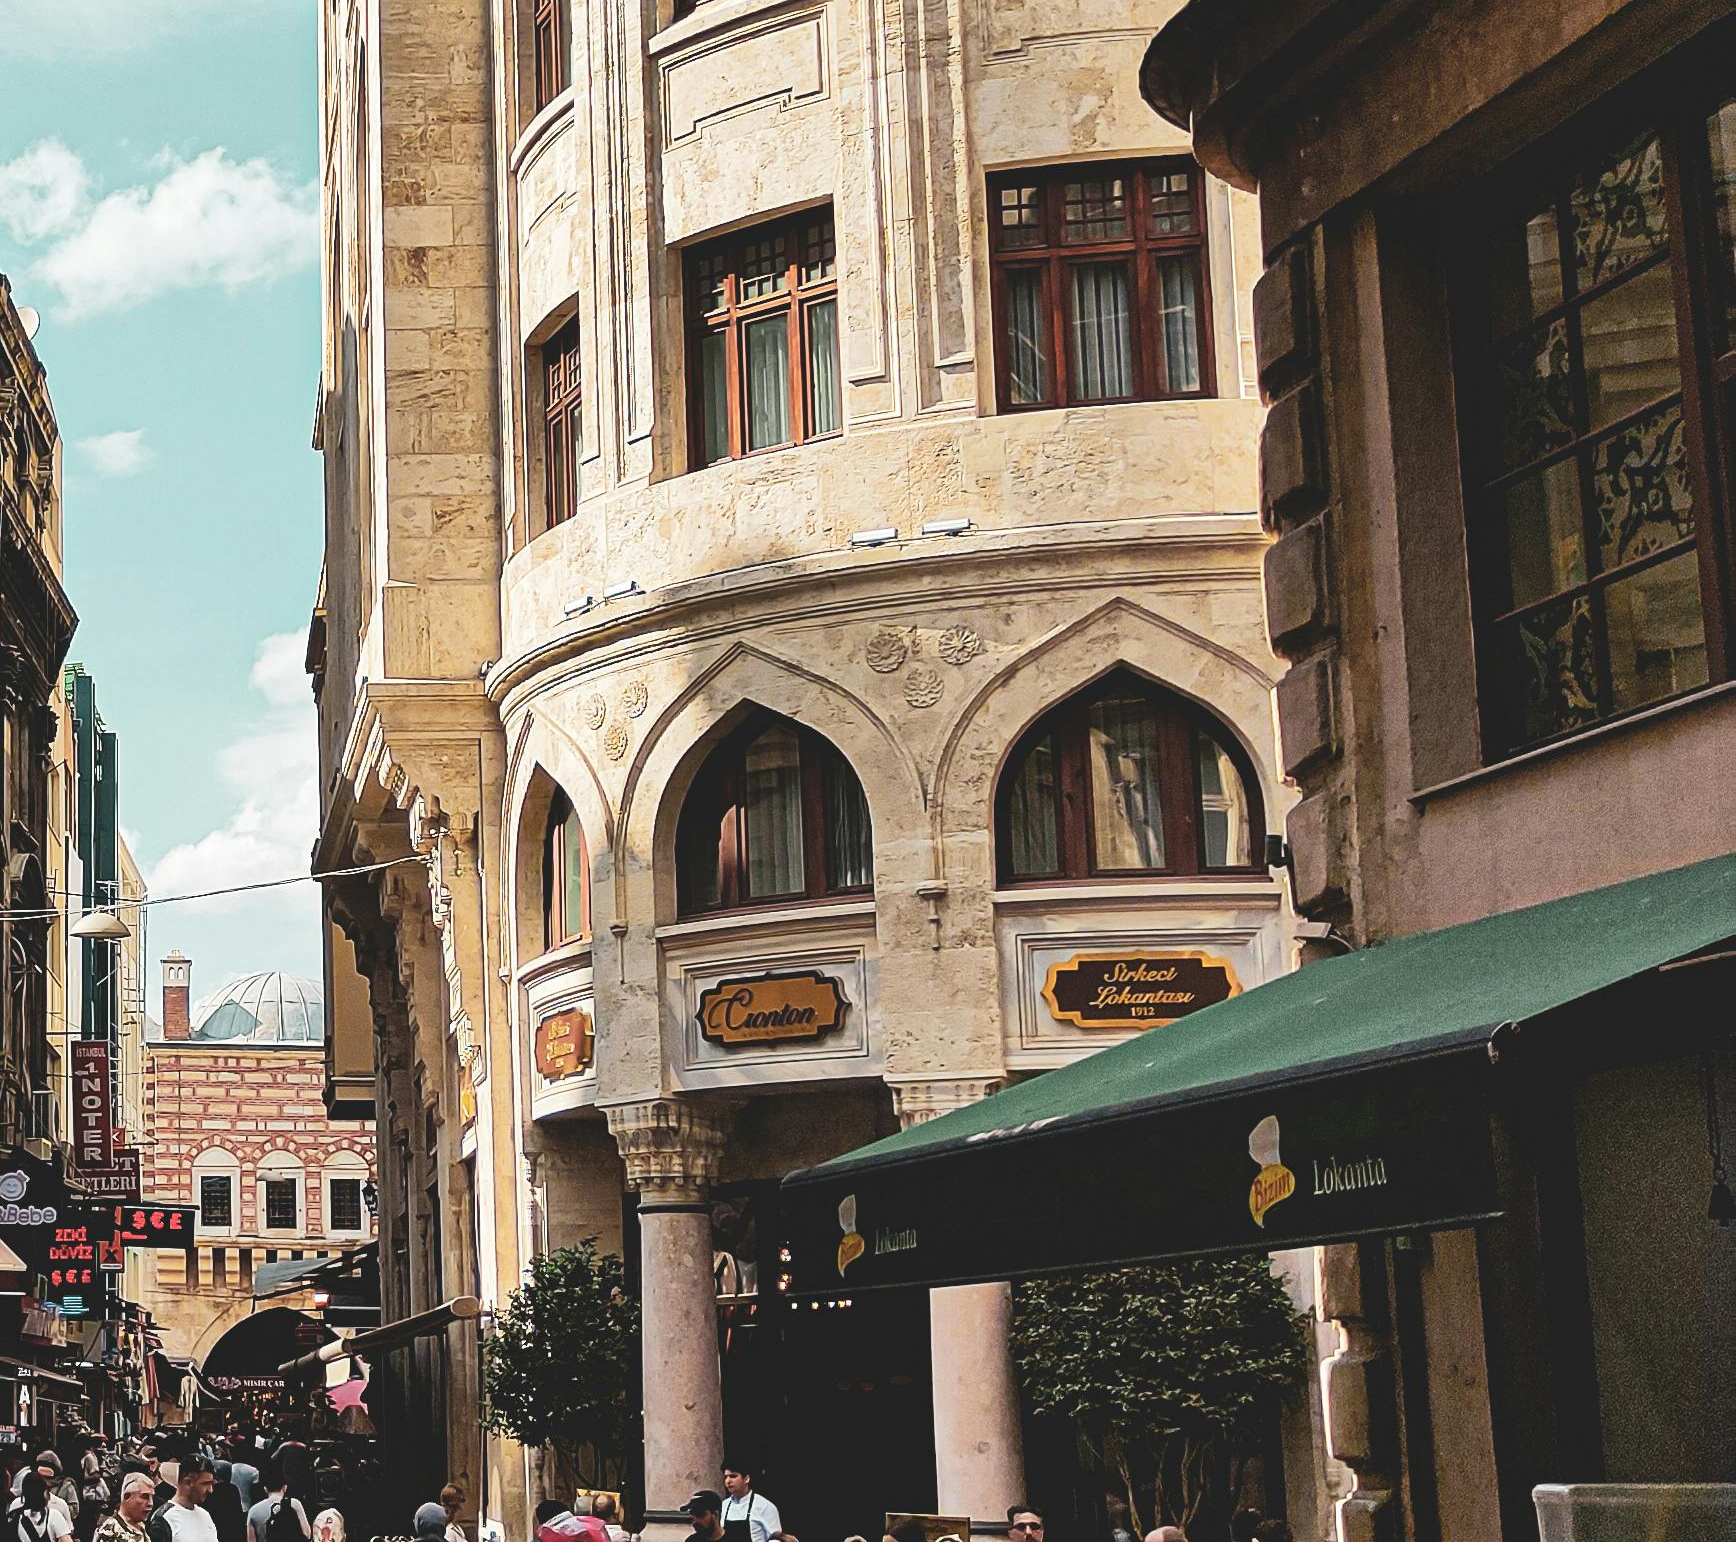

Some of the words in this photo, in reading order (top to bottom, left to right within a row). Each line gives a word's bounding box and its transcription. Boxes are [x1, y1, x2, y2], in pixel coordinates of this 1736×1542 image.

[1103, 962, 1178, 982] Sirkeci
[1130, 1006, 1156, 1017] 1912
[80, 1078, 103, 1161] NOTER
[1253, 1172, 1292, 1214] Bizim
[1313, 1155, 1388, 1196] Lokanta
[49, 1244, 93, 1260] DÖVİZ
